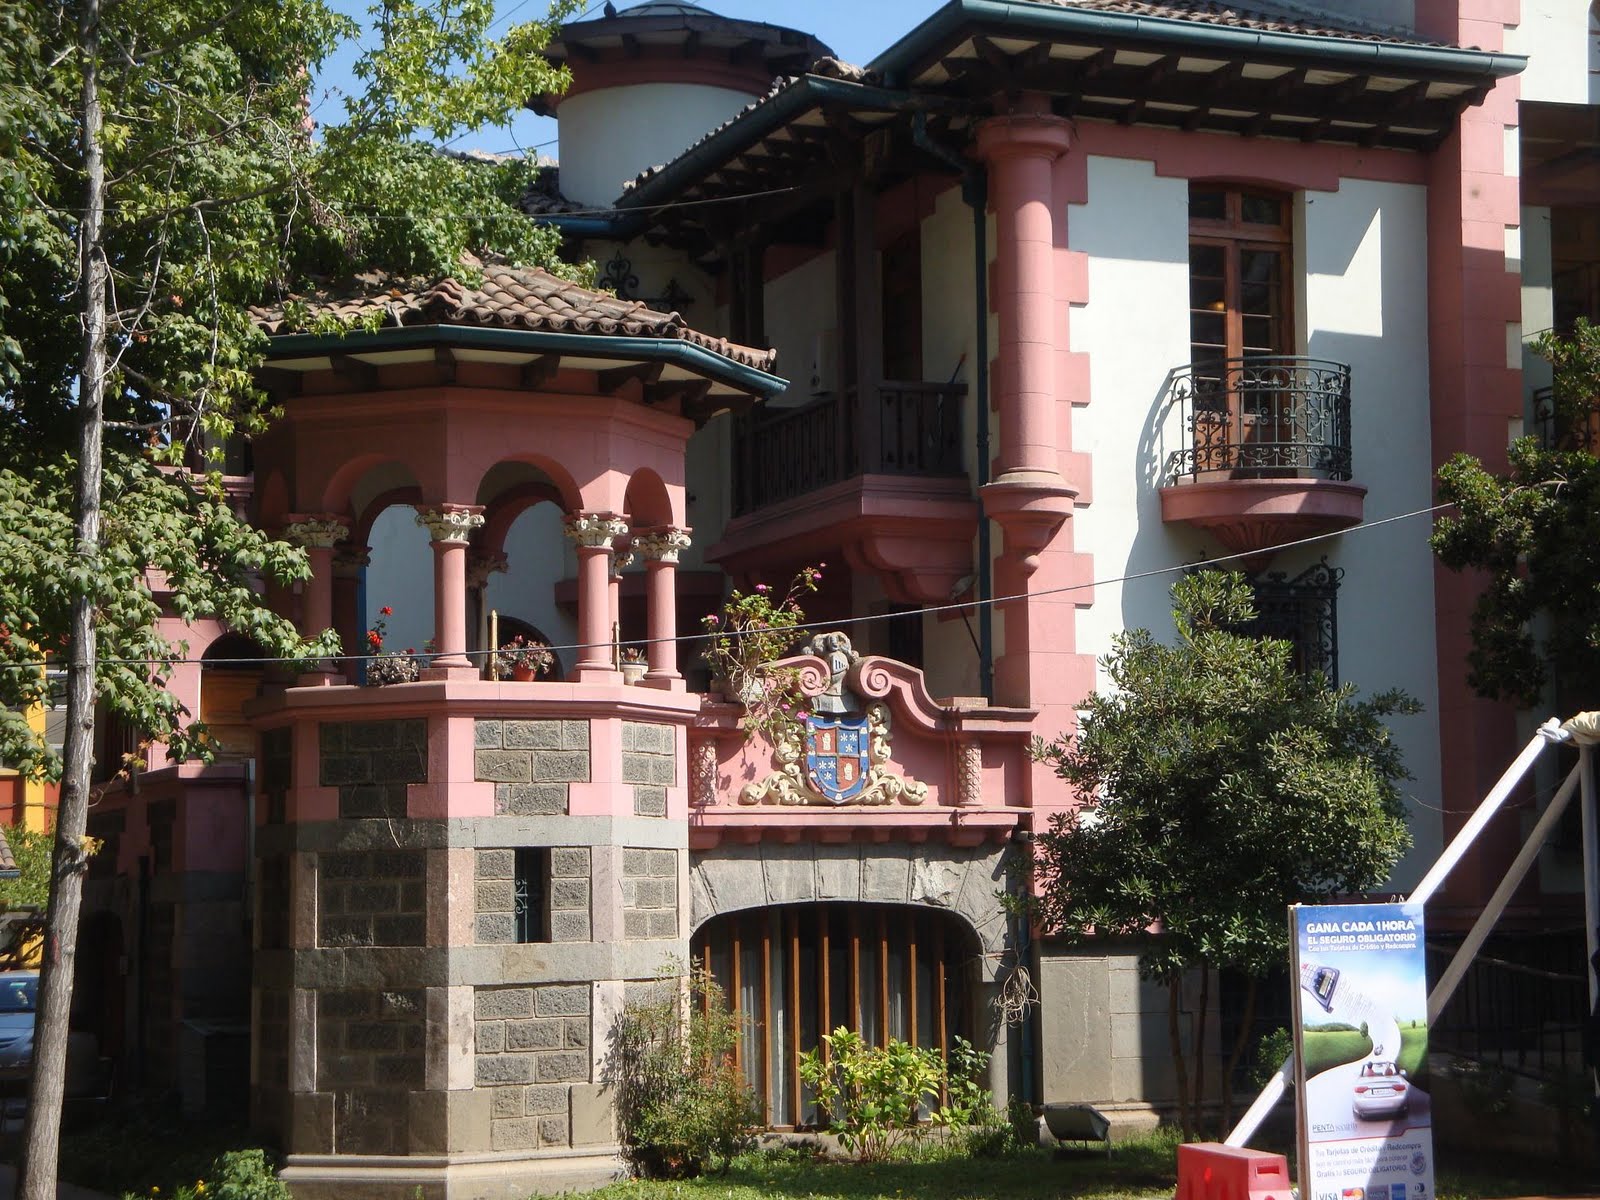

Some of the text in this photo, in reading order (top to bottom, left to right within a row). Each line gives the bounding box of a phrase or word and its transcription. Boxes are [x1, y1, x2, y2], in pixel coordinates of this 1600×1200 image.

[1306, 922, 1341, 934] GANA
[1342, 921, 1375, 932] CADA
[1307, 933, 1417, 945] EL SEGURO OBLIGATORIO
[1343, 1167, 1368, 1176] SEGURO
[1319, 1191, 1338, 1200] VISA
